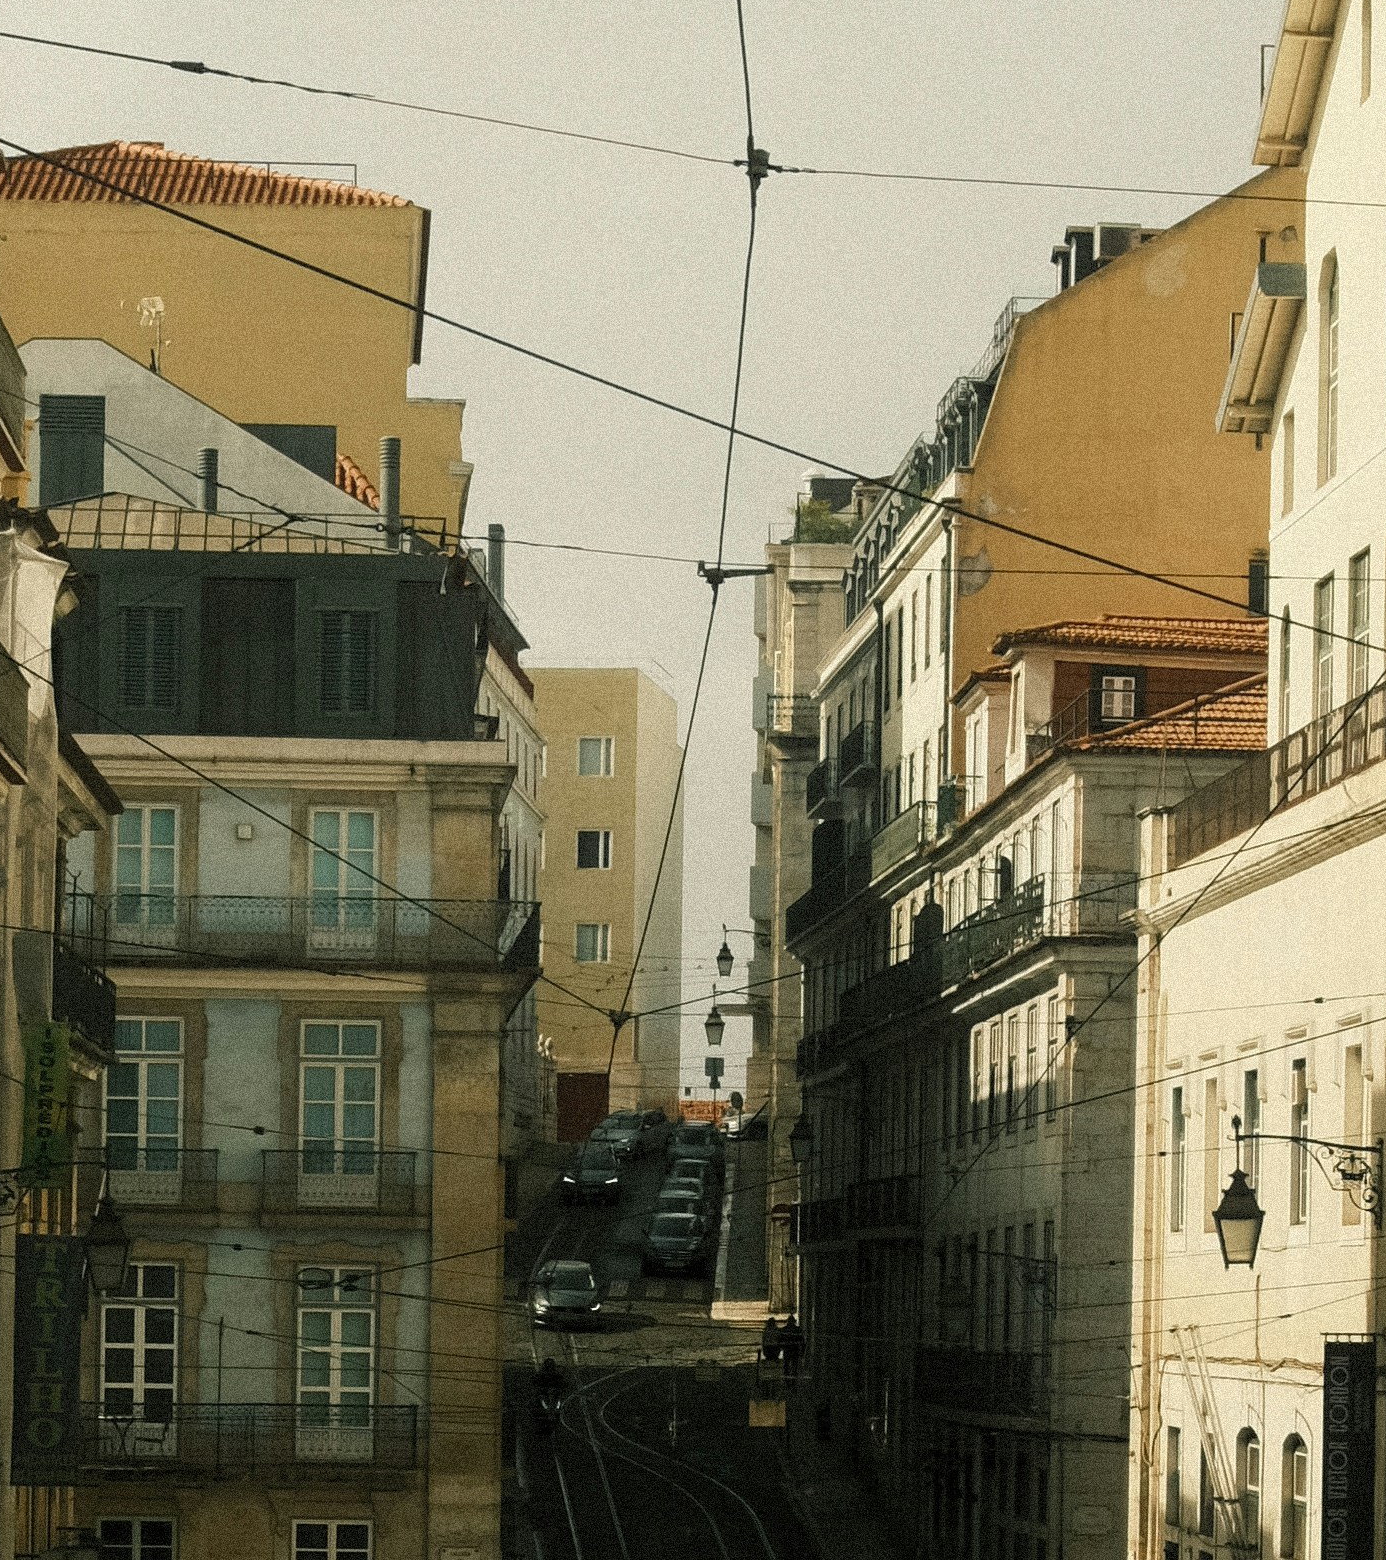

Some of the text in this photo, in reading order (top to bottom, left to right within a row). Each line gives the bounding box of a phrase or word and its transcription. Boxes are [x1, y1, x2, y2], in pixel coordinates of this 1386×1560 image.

[26, 1242, 68, 1449] TRILHO
[1328, 1355, 1351, 1433] CORDON
[1326, 1441, 1350, 1500] VICTOR
